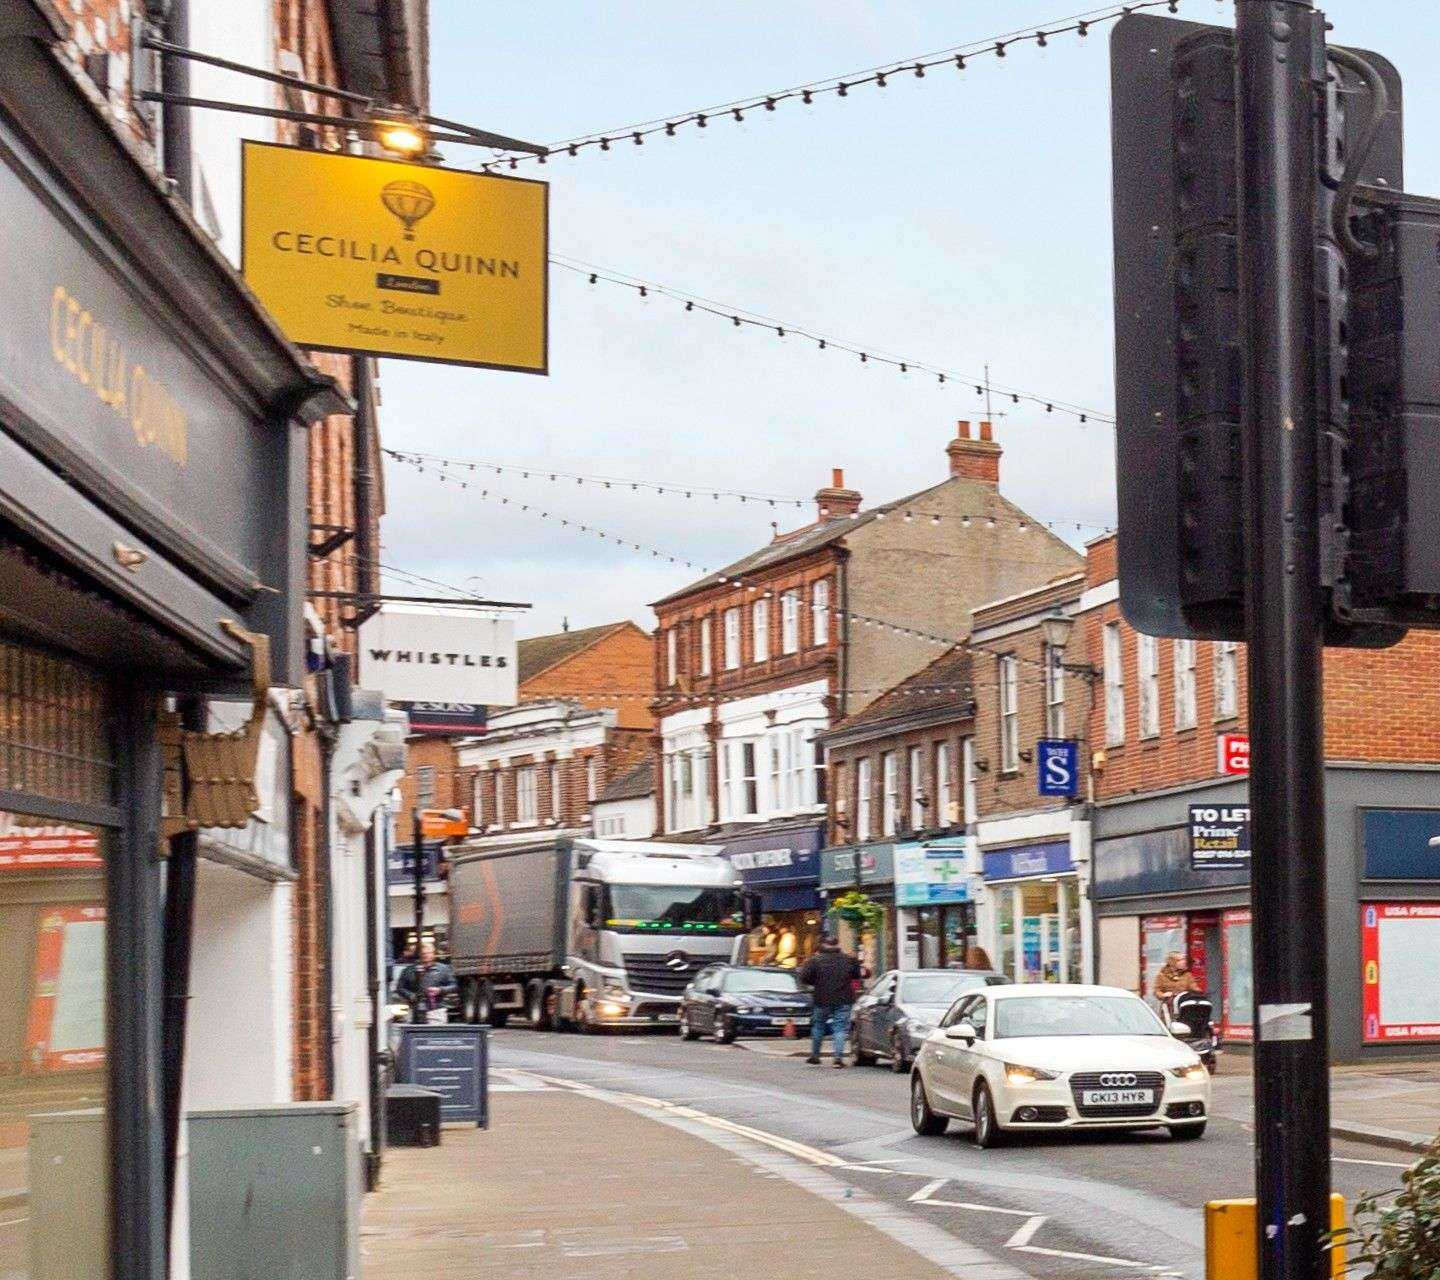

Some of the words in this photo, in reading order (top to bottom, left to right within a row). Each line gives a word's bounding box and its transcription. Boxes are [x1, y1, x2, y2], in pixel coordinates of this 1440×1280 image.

[272, 230, 401, 264] CECILIA
[415, 248, 520, 279] QUINN
[369, 648, 507, 669] WHISTLES
[1045, 756, 1071, 785] S
[1191, 808, 1219, 822] TO
[1221, 808, 1250, 822] LET
[1091, 1092, 1118, 1103] GK13
[1122, 1091, 1146, 1102] HYR
